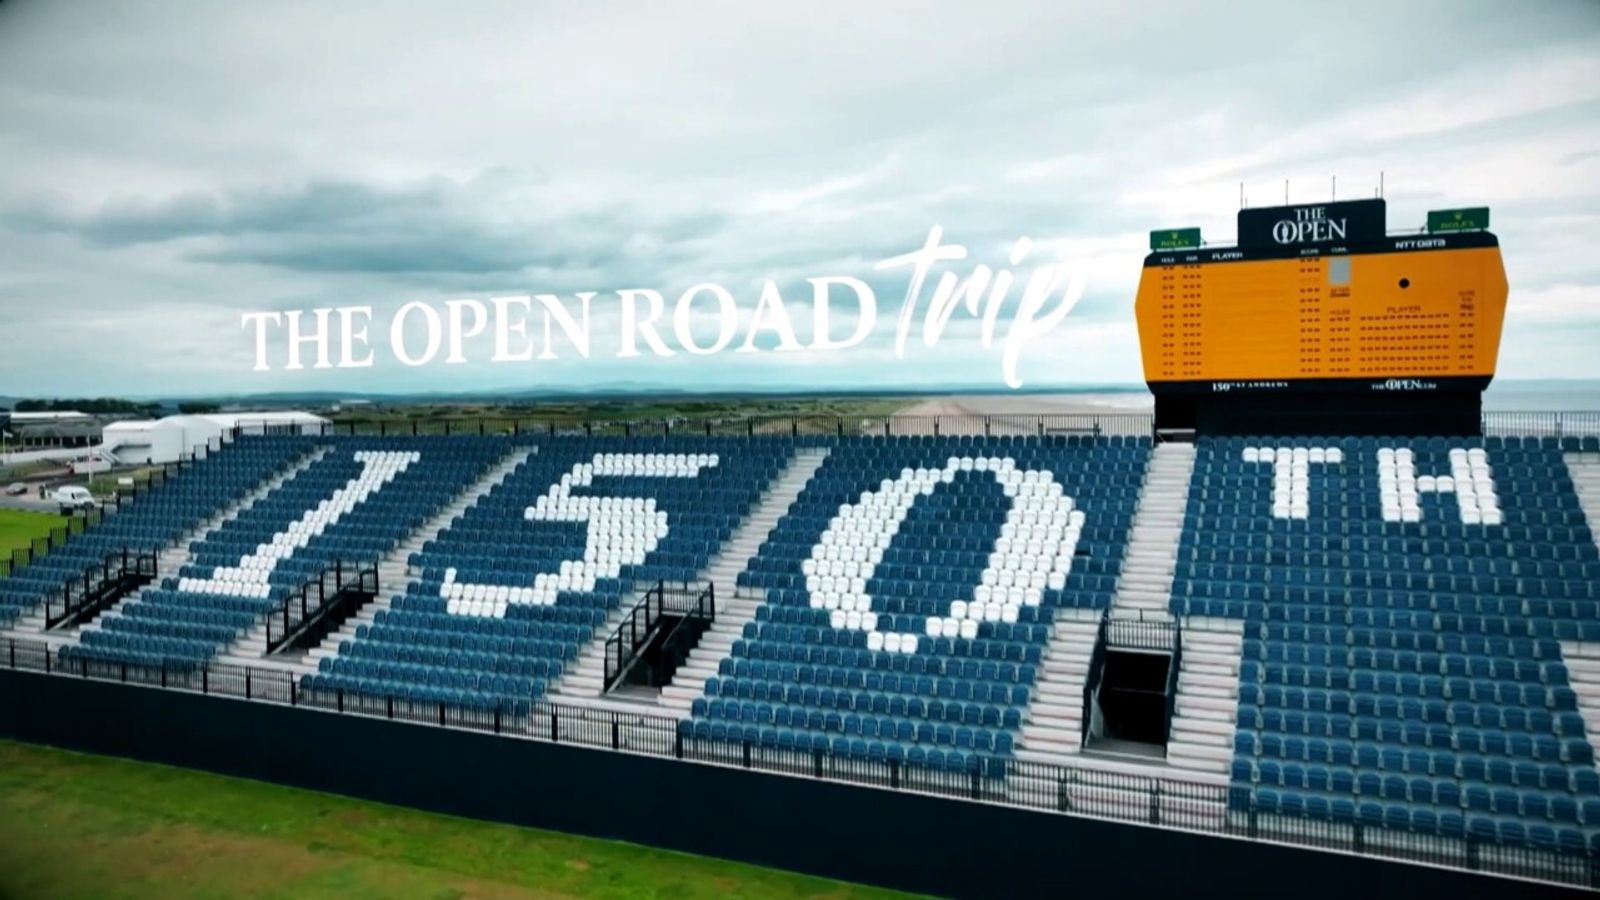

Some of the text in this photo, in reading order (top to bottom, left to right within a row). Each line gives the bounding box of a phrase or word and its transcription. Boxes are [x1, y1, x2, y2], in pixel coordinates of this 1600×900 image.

[1294, 206, 1326, 221] THE
[1272, 218, 1347, 244] OPEN
[1211, 252, 1243, 260] PLAYER
